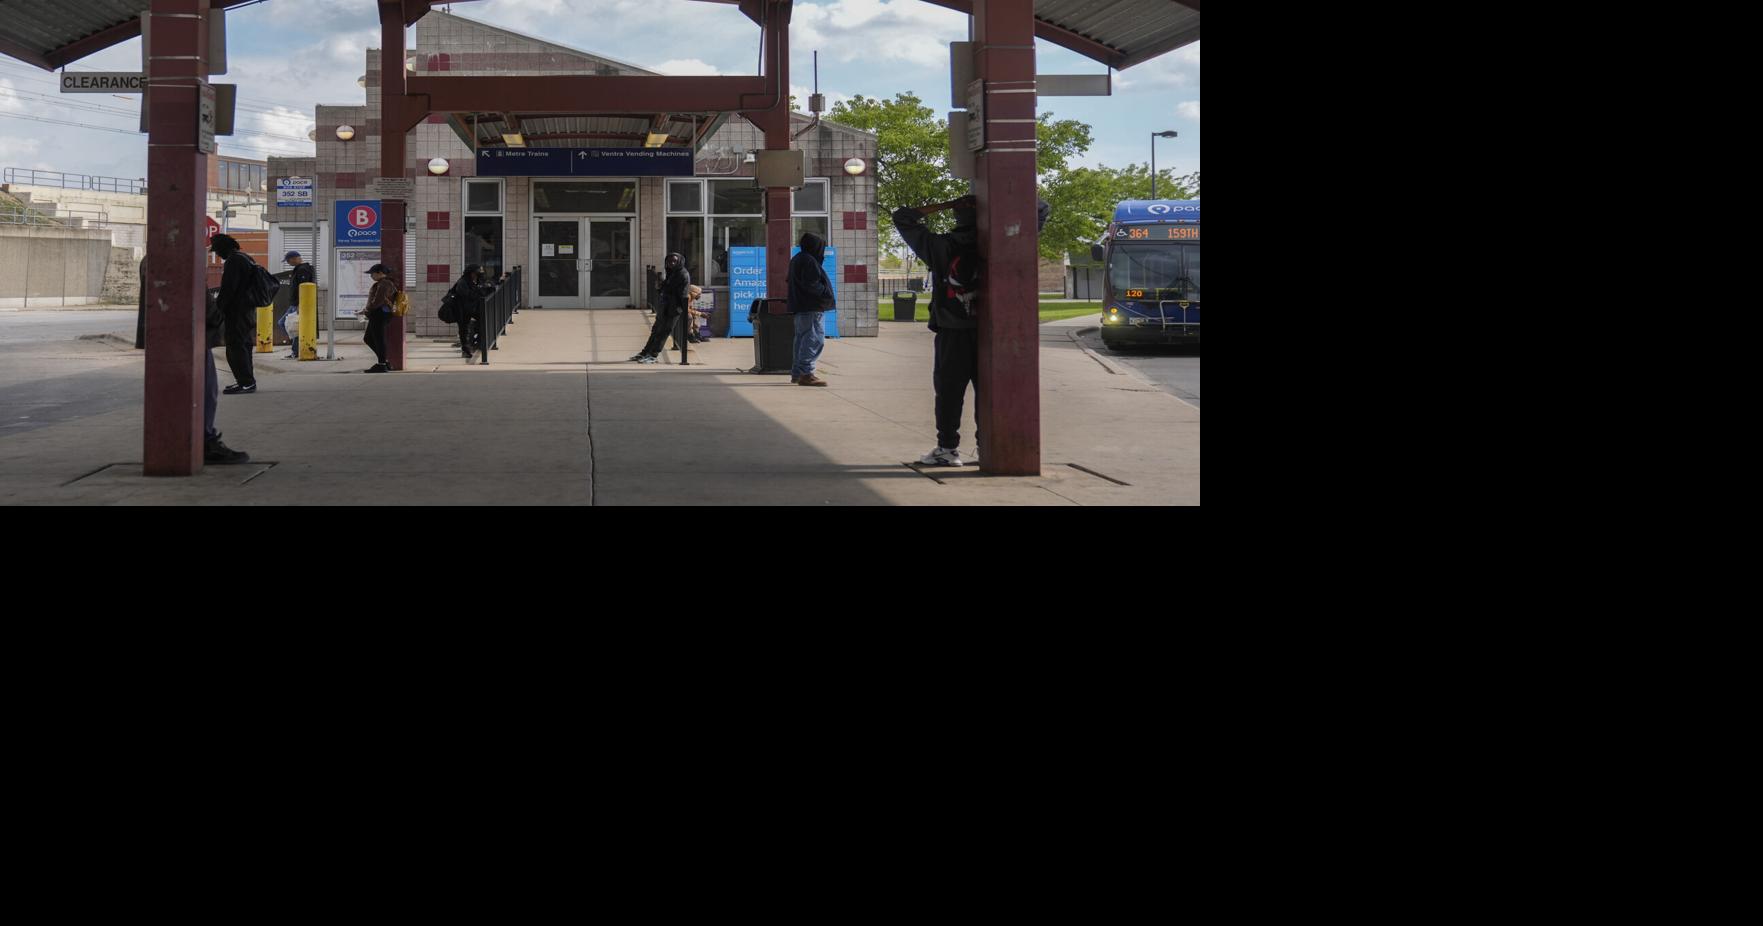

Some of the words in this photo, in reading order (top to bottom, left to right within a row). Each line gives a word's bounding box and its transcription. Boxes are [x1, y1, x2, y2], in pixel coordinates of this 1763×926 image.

[356, 209, 369, 226] B
[1129, 228, 1149, 239] 364
[1167, 227, 1199, 239] 159TH
[733, 266, 763, 275] Order
[733, 290, 753, 300] pick
[1126, 289, 1143, 297] 120
[734, 302, 750, 311] her
